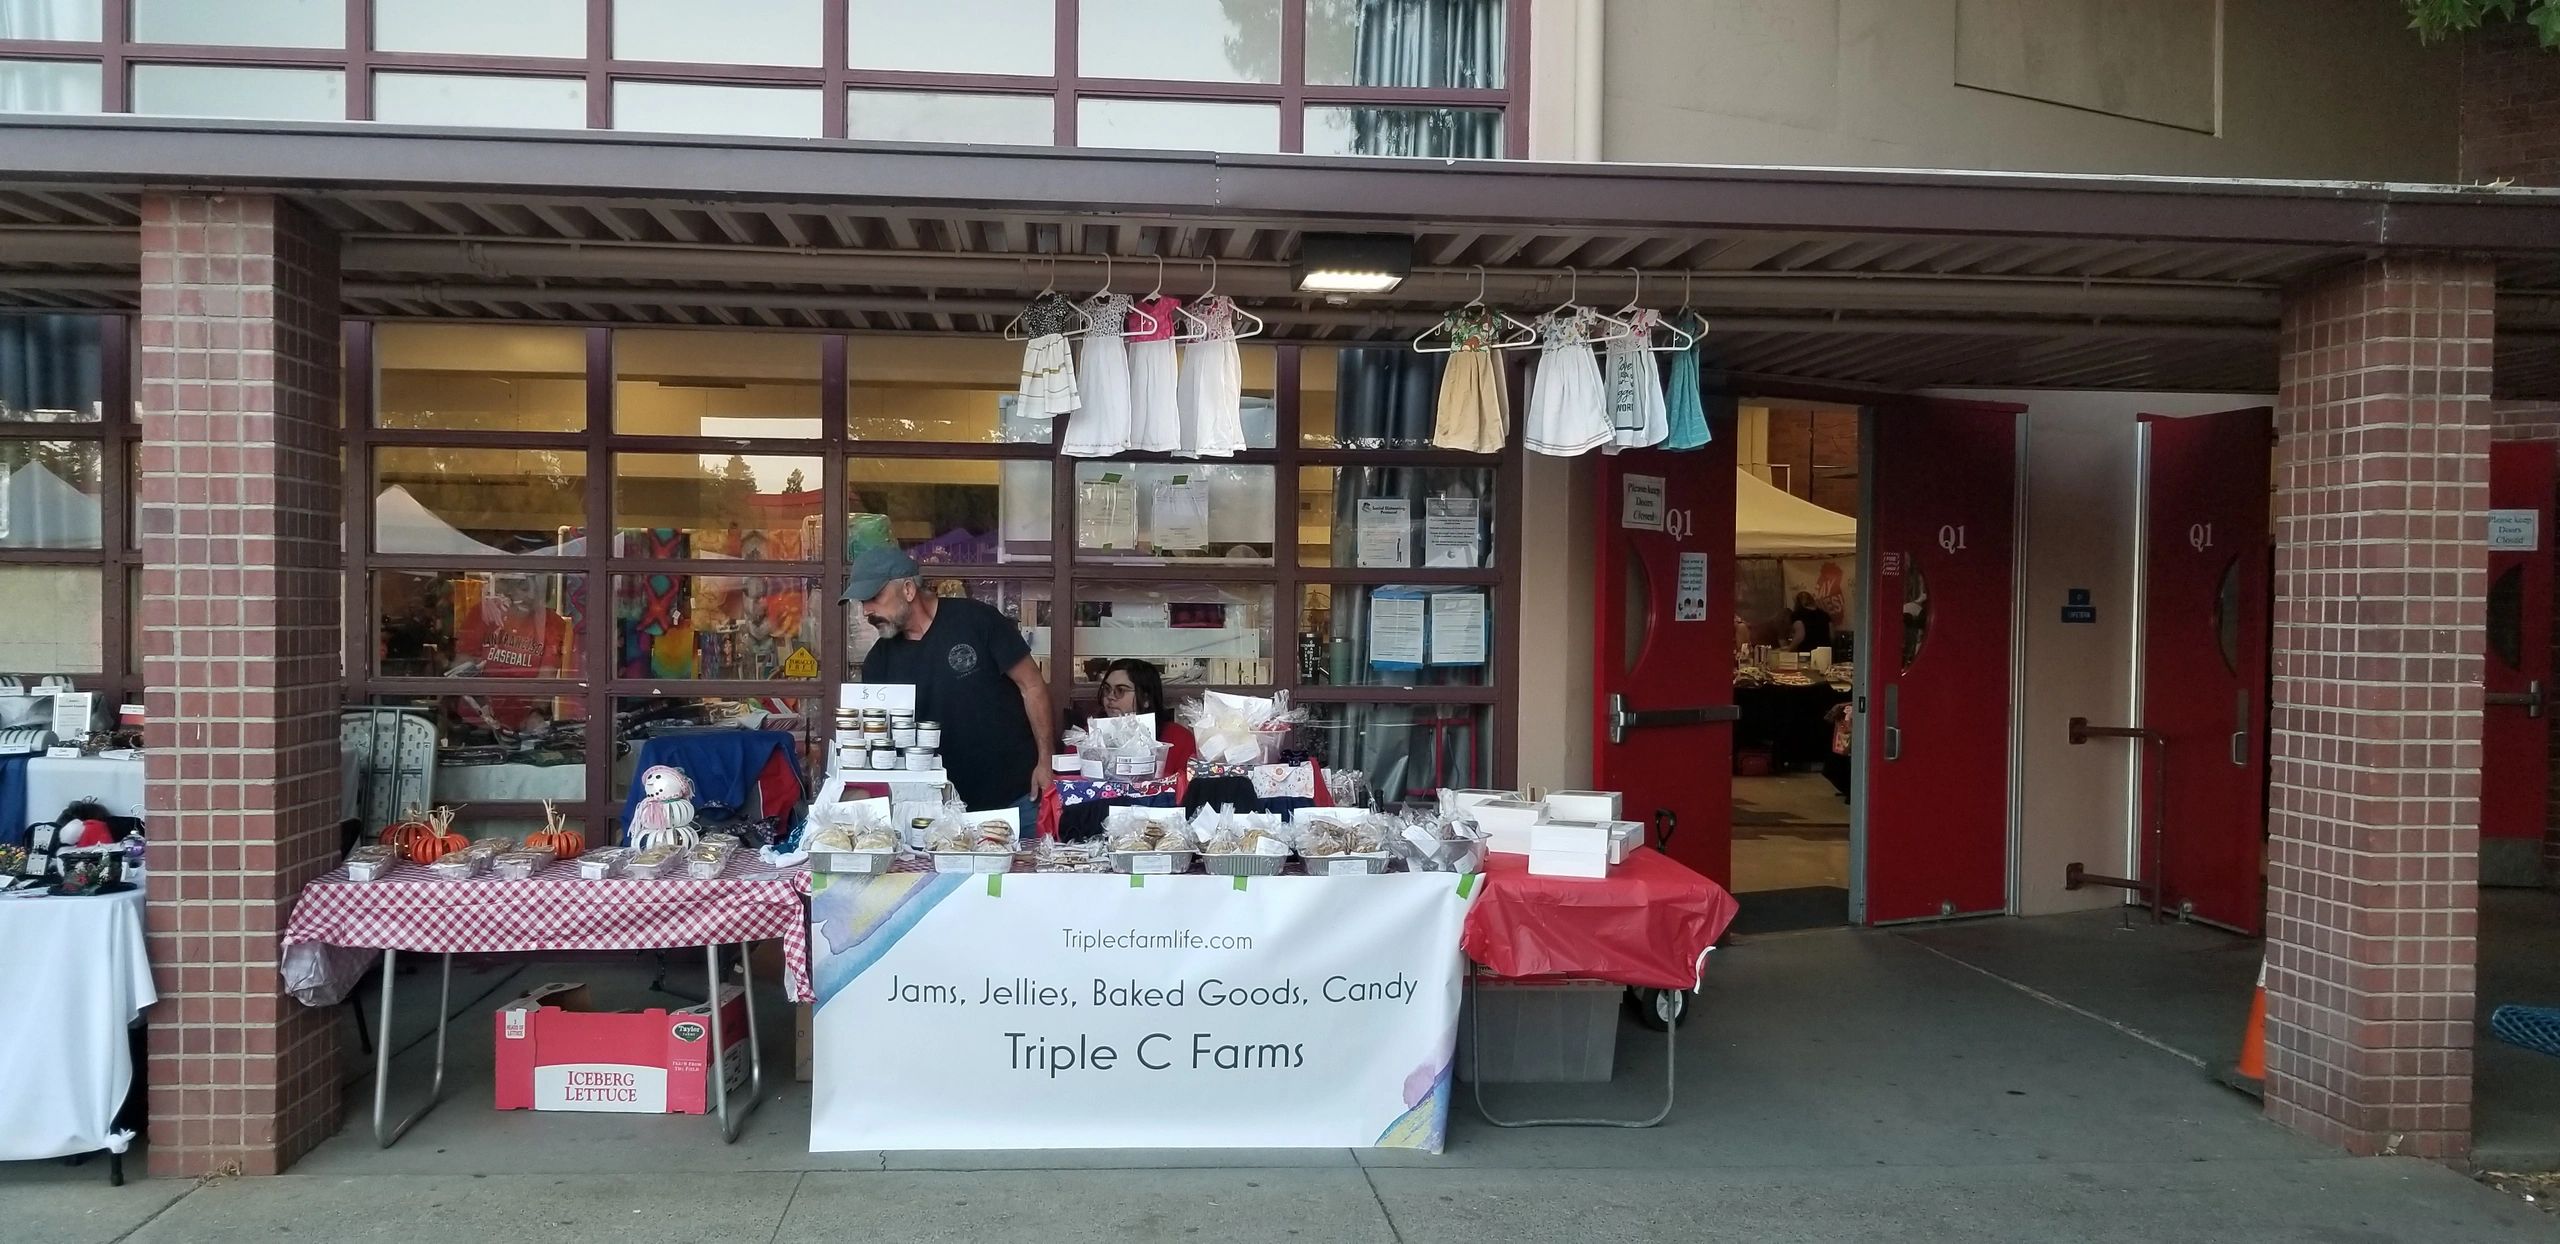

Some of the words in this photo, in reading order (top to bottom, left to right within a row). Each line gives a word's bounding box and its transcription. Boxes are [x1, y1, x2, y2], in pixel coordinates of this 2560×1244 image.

[1636, 497, 1653, 507] Doors
[1633, 510, 1655, 521] Closed
[1666, 508, 1693, 541] Q1
[1939, 525, 1967, 554] Q1
[2189, 523, 2214, 552] Q1
[2496, 536, 2524, 544] Closed
[487, 647, 532, 667] BASEBALL
[1063, 929, 1252, 952] Triplecfarmlife.com
[888, 975, 966, 1006] Jams,
[980, 977, 1077, 1008] Jellies,
[1094, 978, 1184, 1007] Baked
[1199, 978, 1308, 1007] Goods,
[1323, 972, 1418, 1004] Candy
[1004, 1033, 1118, 1078] Triple
[1137, 1033, 1172, 1070] C
[1193, 1033, 1304, 1070] Farms
[568, 1071, 635, 1086] ICEBERG
[565, 1086, 637, 1102] LETTUCE
